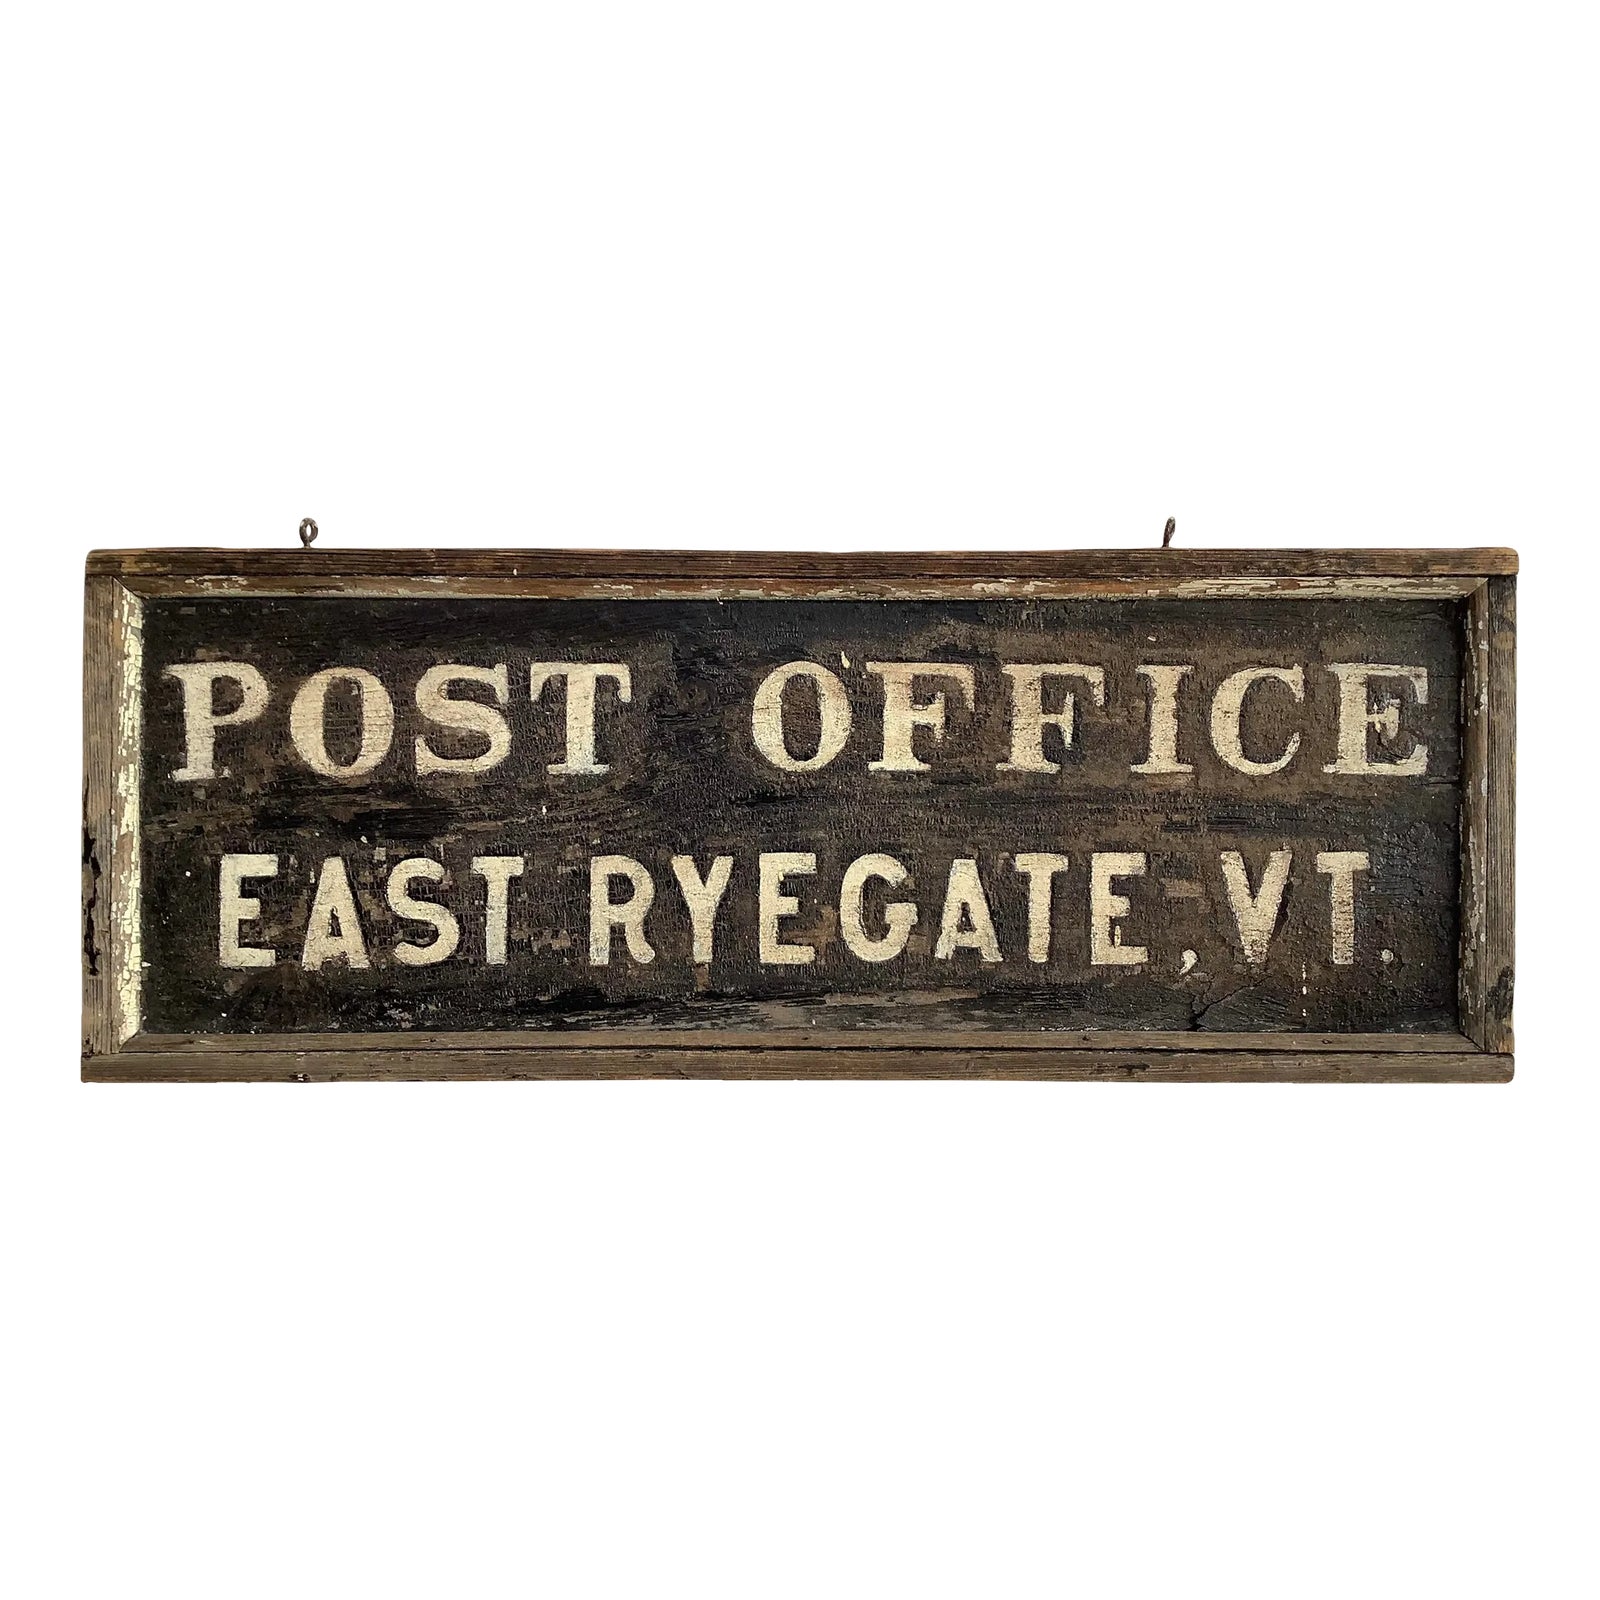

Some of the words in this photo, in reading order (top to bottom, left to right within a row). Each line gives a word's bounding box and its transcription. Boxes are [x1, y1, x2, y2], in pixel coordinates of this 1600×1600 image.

[165, 660, 632, 782] POST
[751, 660, 1429, 780] OFFICE
[217, 852, 525, 971] EAST
[587, 850, 1198, 977] RYEGATE,
[1220, 850, 1394, 967] VT.
